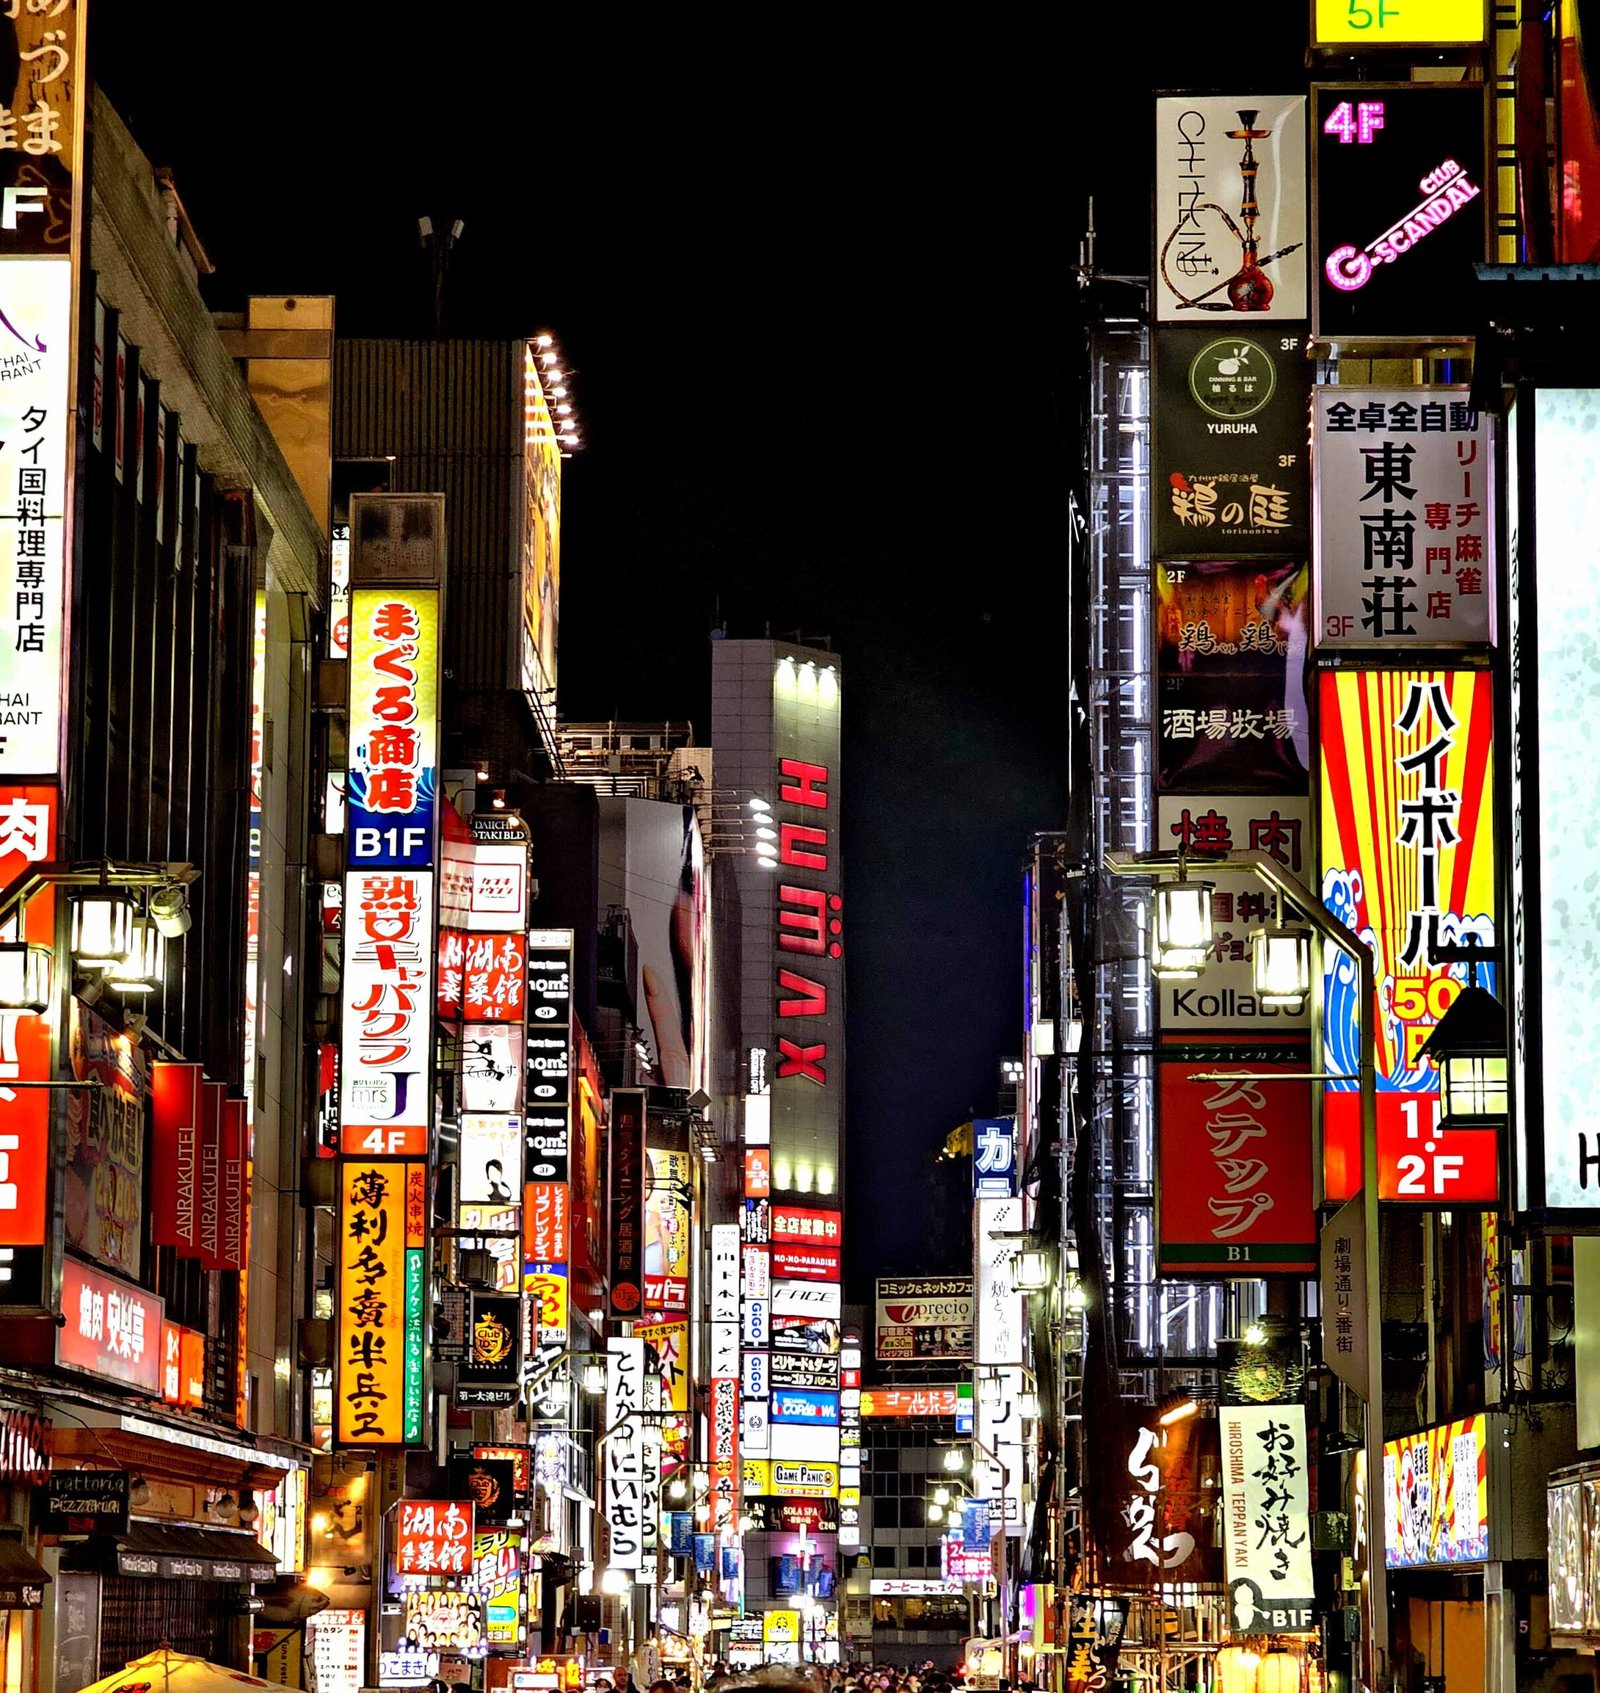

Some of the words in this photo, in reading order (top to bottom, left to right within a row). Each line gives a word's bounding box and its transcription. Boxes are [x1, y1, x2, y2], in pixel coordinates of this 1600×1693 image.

[1324, 102, 1384, 143] 4F
[1419, 159, 1460, 195] CLUB
[1280, 338, 1298, 350] 3F
[1207, 423, 1258, 434] YURUHA
[1326, 401, 1479, 432] 全卓全自動
[1278, 455, 1296, 467] 3F
[1171, 481, 1293, 528] 鶏の庭
[1455, 439, 1483, 596] リーチ麻雀
[15, 406, 47, 653] タイ国料理専門店
[1358, 441, 1418, 638] 東南荘
[1166, 570, 1186, 583] 2F
[1424, 502, 1452, 620] 専門店
[1326, 616, 1354, 638] 3F
[368, 602, 418, 811] まぐろ商店
[1163, 709, 1299, 740] 酒場牧場
[355, 827, 426, 857] B1F
[504, 830, 524, 839] BLD
[1397, 684, 1457, 967] ハイボール
[777, 757, 843, 1087] HUMAX
[466, 937, 523, 972] 湖南
[483, 1006, 503, 1018] 4F
[362, 1128, 406, 1154] 4F
[1202, 1068, 1275, 1238] ステップ
[176, 1126, 194, 1240] ANRAKUTEI
[1396, 1155, 1465, 1194] 2F
[202, 1143, 219, 1251] ANRAKUTEI
[225, 1159, 241, 1265] ANRAKUTEI
[407, 1171, 424, 1237] 炭火串焼
[535, 1186, 550, 1261] リフレッシュ
[774, 1215, 837, 1237] 全店営業中
[535, 1264, 552, 1274] 1F
[1227, 1246, 1251, 1261] B1
[751, 1302, 762, 1338] GiGO
[751, 1357, 762, 1393] GiGO
[1227, 1421, 1245, 1485] HIROSHIMA
[1252, 1419, 1306, 1581] お好み焼き
[402, 1503, 469, 1540] 湖南
[1273, 1609, 1312, 1627] B1F
[1519, 1620, 1529, 1634] 5
